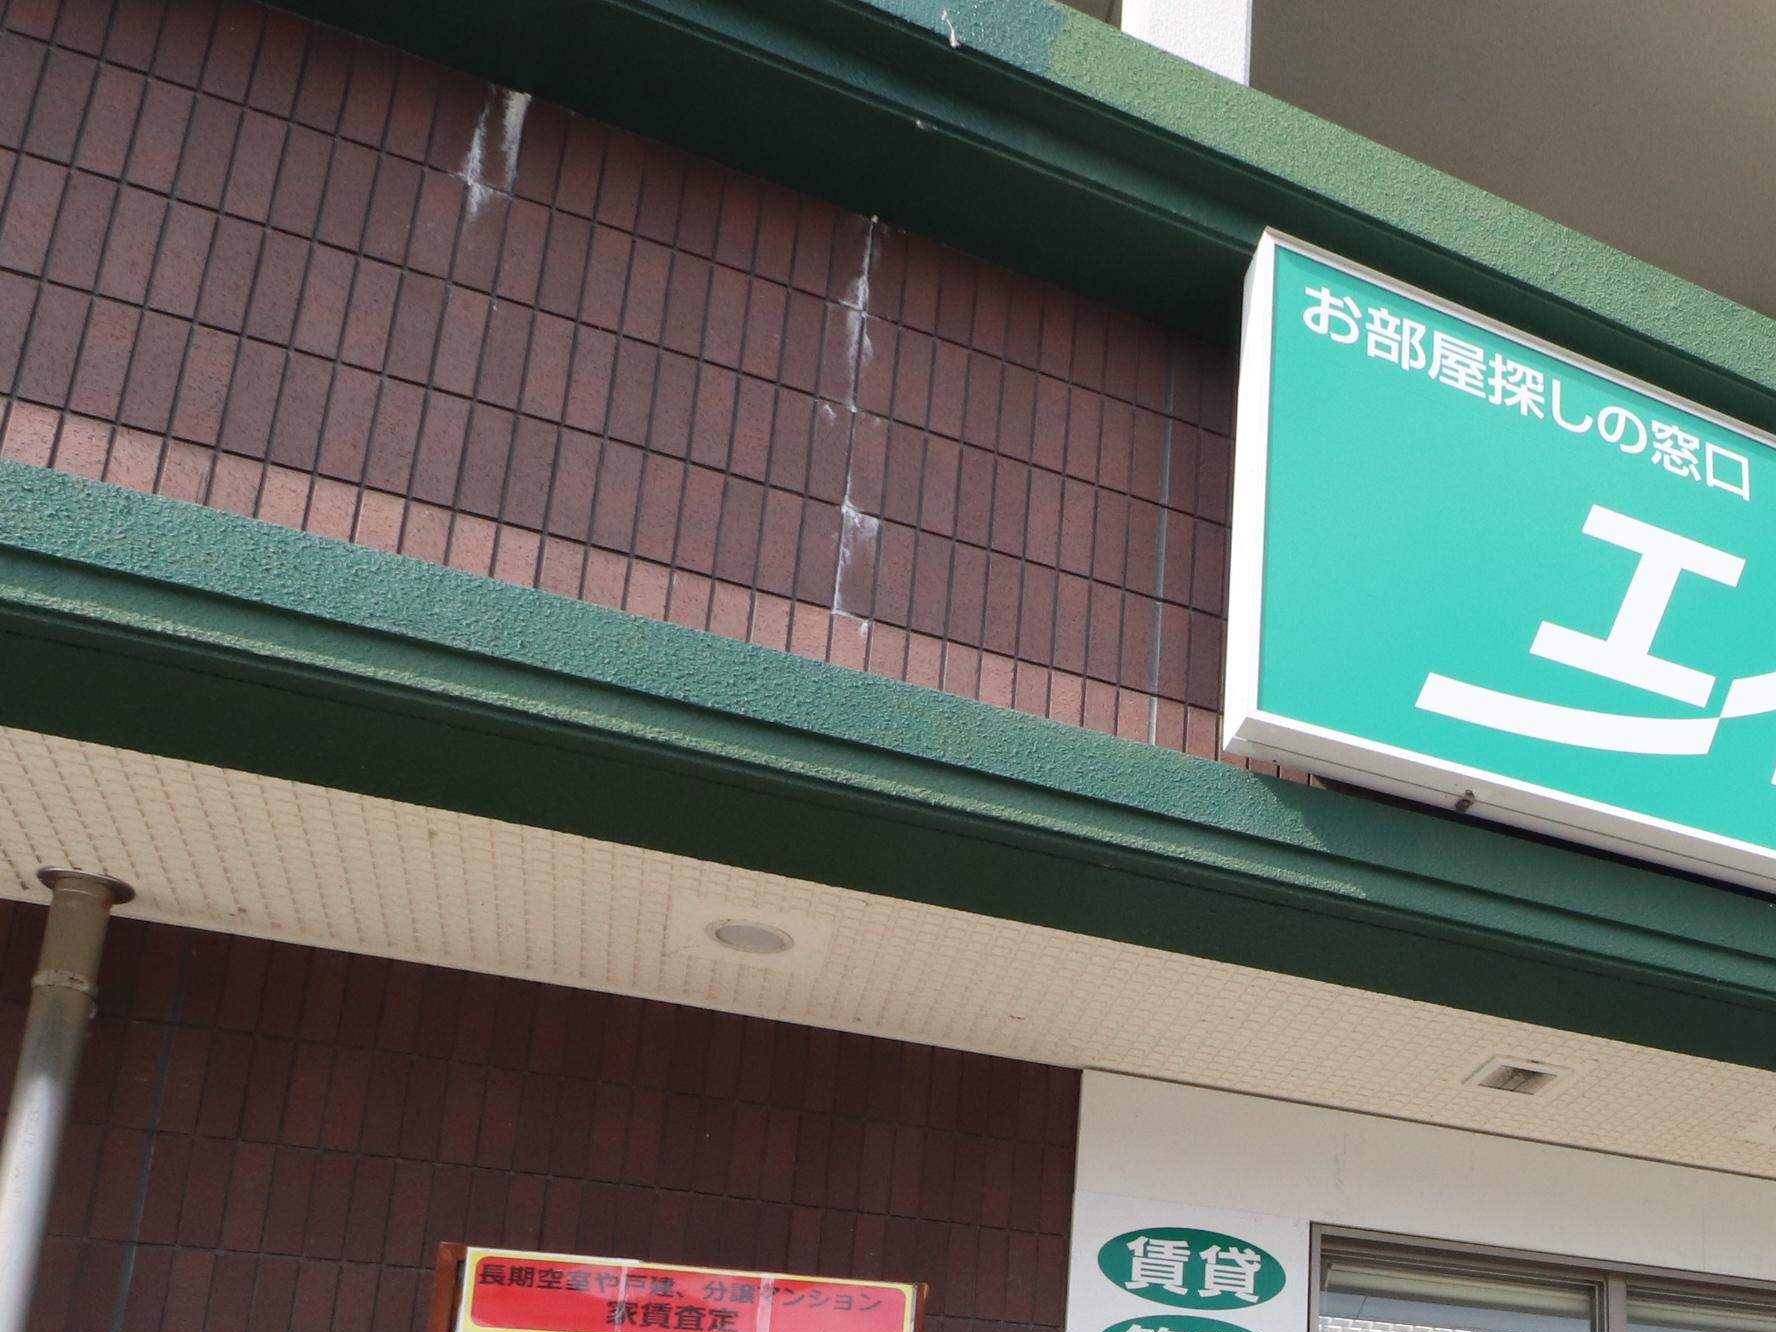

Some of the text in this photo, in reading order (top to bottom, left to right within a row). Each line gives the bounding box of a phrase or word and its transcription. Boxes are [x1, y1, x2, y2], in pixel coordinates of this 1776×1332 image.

[1302, 285, 1751, 502] お部屋探しの窓口
[1124, 1235, 1262, 1304] 賃貸
